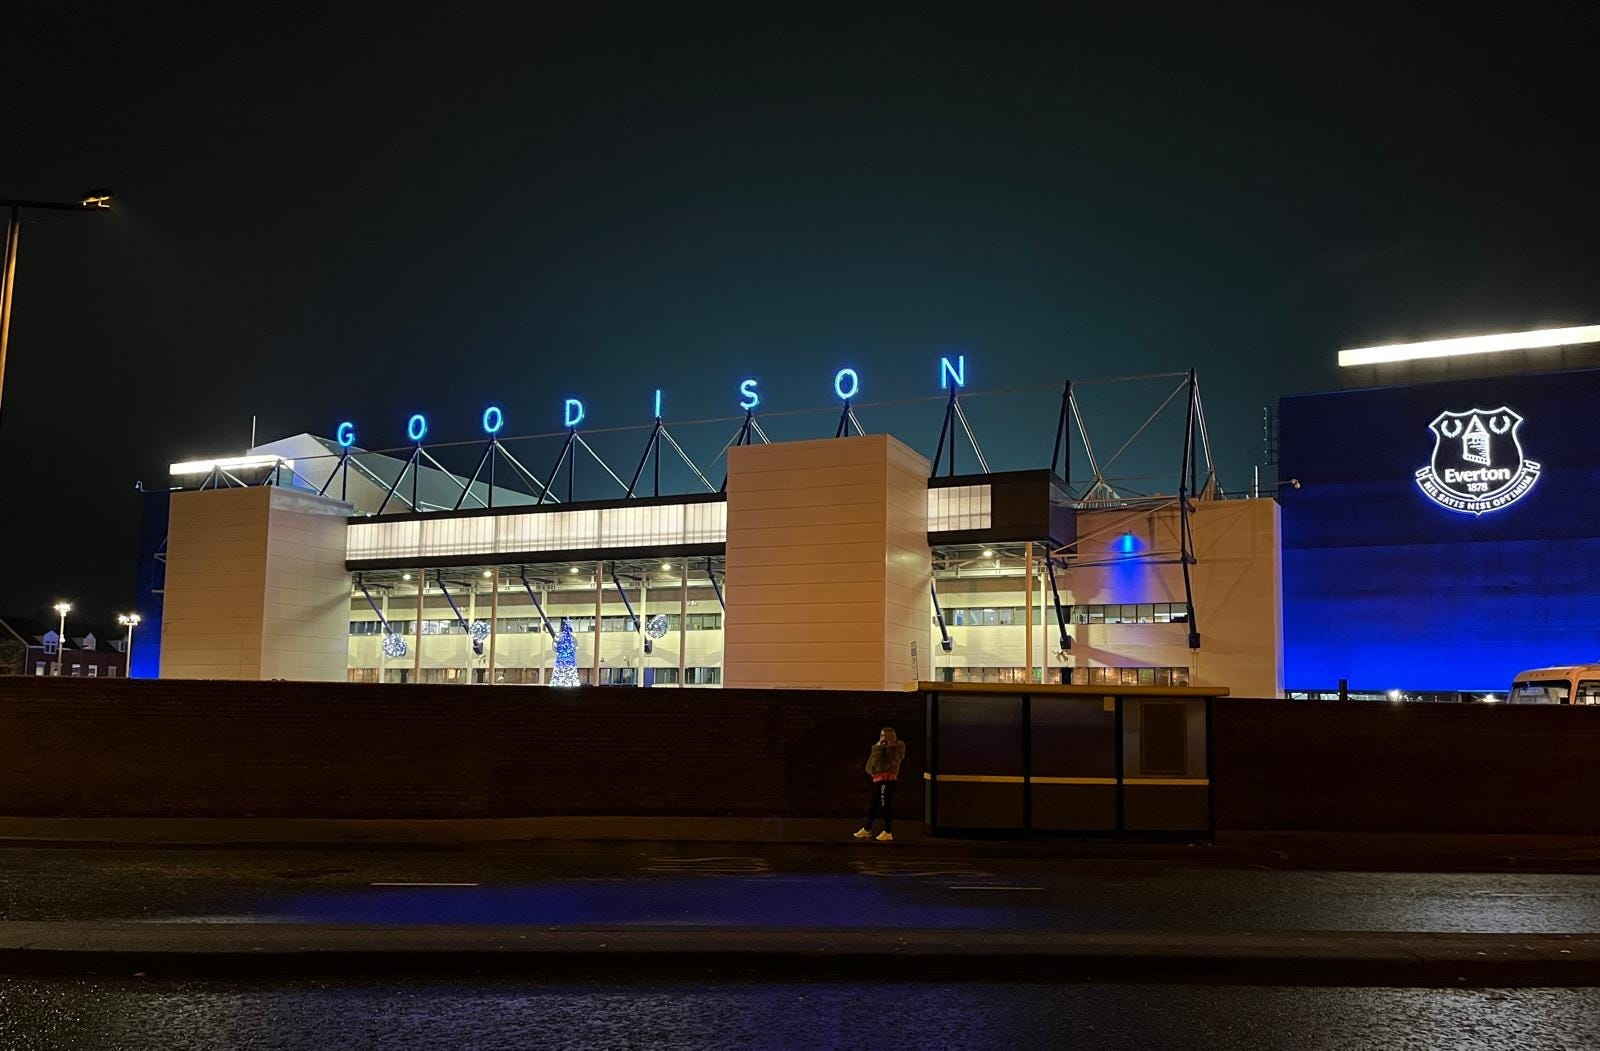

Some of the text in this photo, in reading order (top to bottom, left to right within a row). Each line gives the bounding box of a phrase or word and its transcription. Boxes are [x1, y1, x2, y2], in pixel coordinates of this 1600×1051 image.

[337, 355, 966, 448] GOODISON
[1445, 468, 1510, 483] Everton
[1467, 482, 1488, 492] 1878
[1423, 475, 1533, 510] NIL SATIS NISI OPTIMUM
